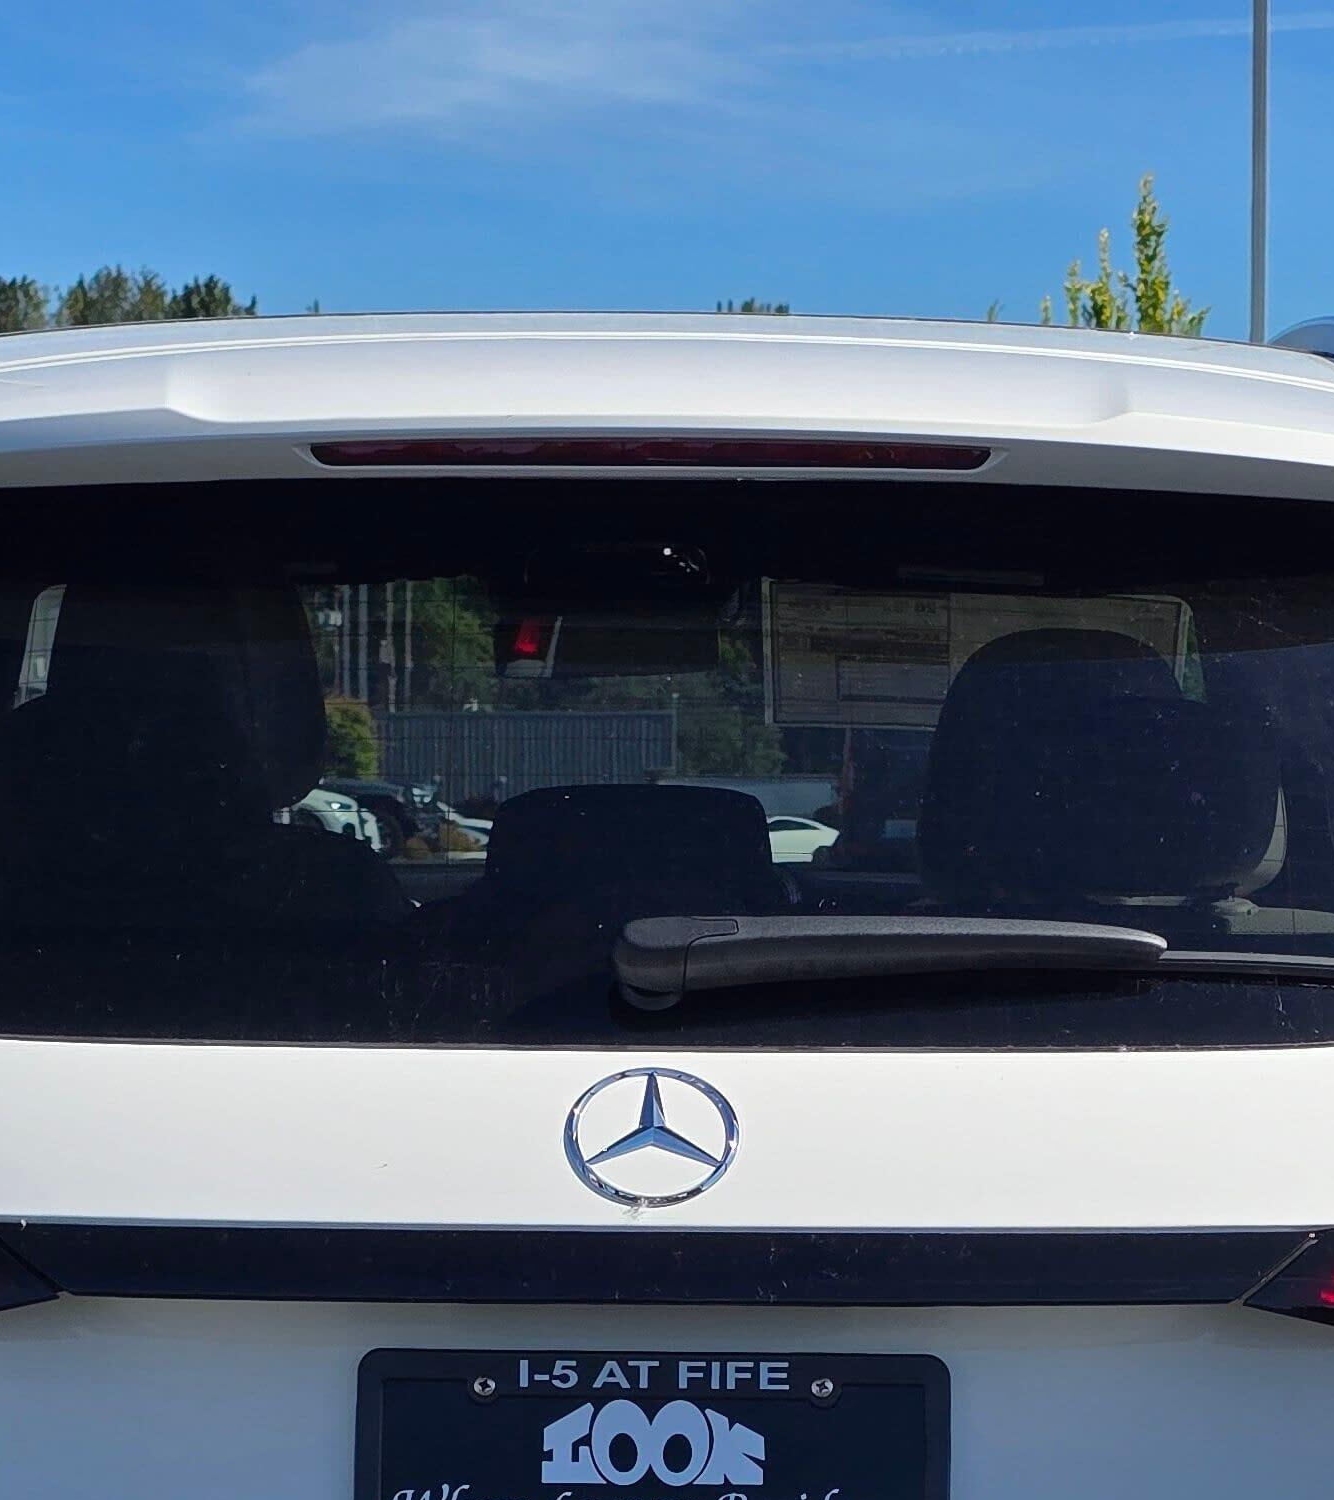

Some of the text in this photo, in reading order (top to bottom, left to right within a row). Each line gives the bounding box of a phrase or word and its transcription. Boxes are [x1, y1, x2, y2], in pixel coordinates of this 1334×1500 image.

[518, 1360, 790, 1391] I-5 AT FIFE
